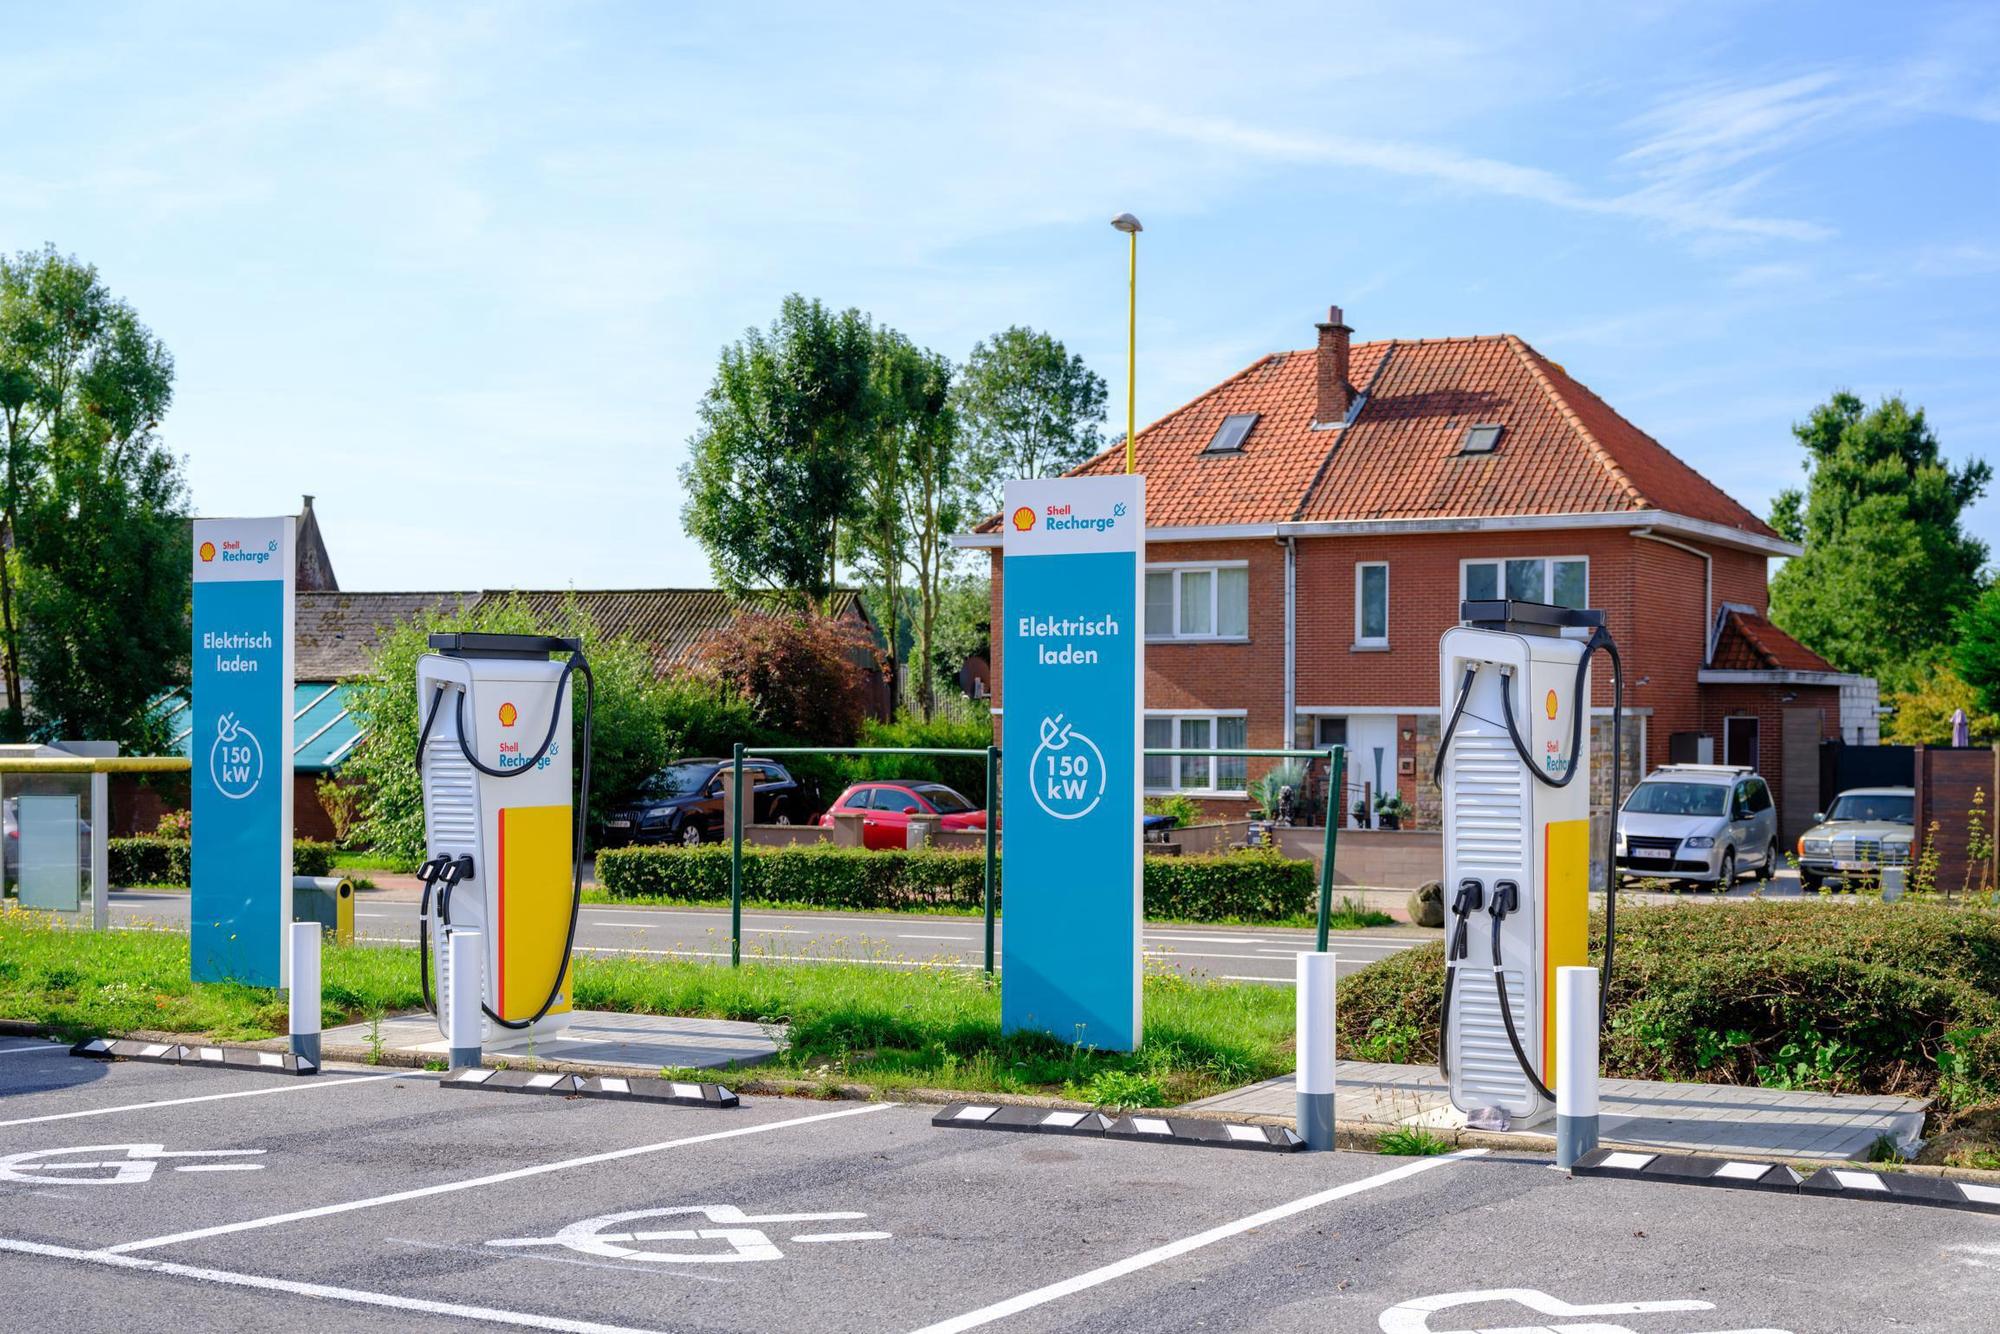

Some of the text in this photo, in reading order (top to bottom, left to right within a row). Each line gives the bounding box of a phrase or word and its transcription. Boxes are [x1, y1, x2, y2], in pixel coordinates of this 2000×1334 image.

[1047, 504, 1070, 516] Shell
[1046, 515, 1114, 532] Recharge
[223, 541, 240, 550] Shell
[222, 549, 269, 564] Recharge
[1019, 614, 1119, 637] Elektrisch
[203, 631, 272, 649] Elektrisch
[216, 654, 258, 672] laden
[1039, 643, 1098, 665] laden
[222, 746, 251, 764] 150
[499, 742, 519, 753] Shell
[223, 764, 251, 783] kW
[1047, 755, 1089, 777] 150
[1047, 777, 1088, 800] kW
